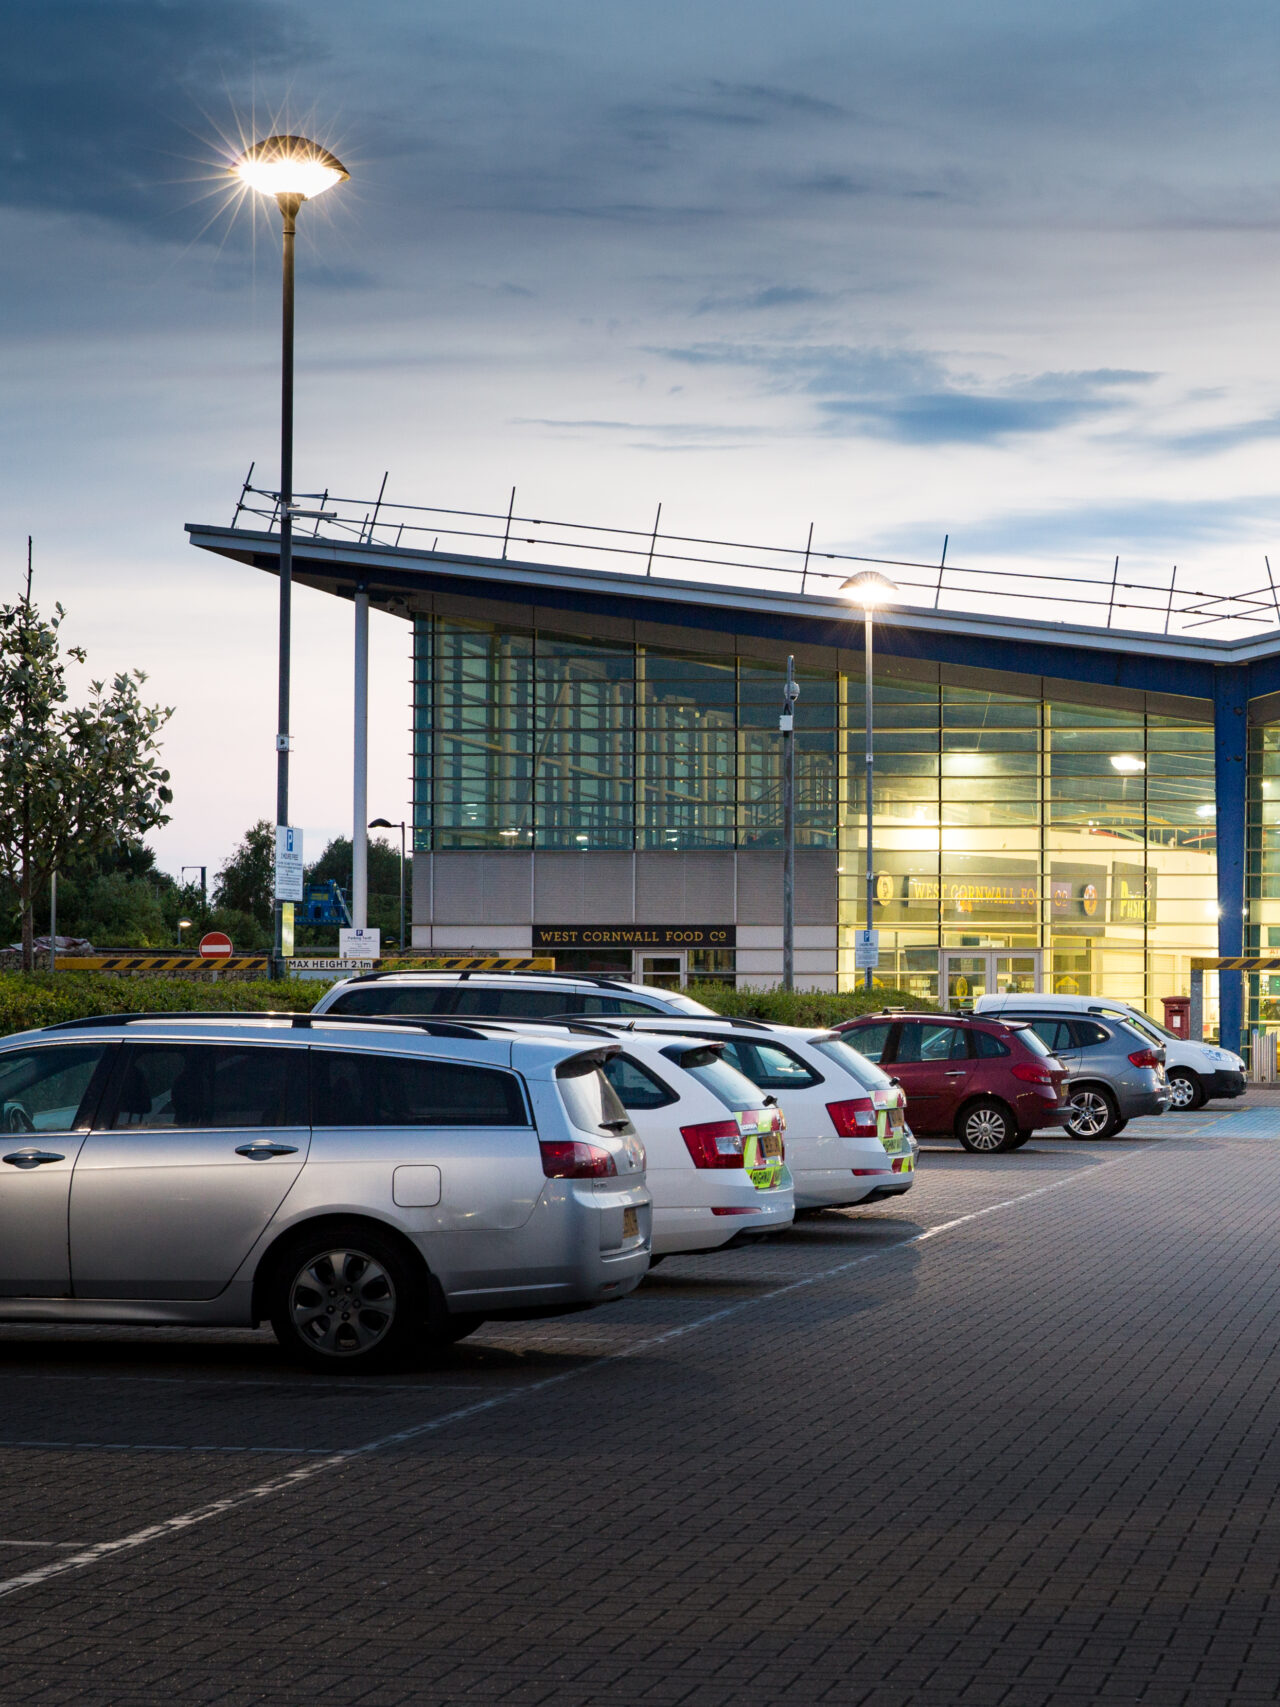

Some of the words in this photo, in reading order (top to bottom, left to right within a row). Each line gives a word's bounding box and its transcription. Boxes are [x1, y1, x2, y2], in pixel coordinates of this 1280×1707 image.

[913, 882, 947, 900] WEST
[540, 931, 578, 942] WEST
[582, 931, 659, 942] CORNWALL
[665, 931, 704, 942] FOOD
